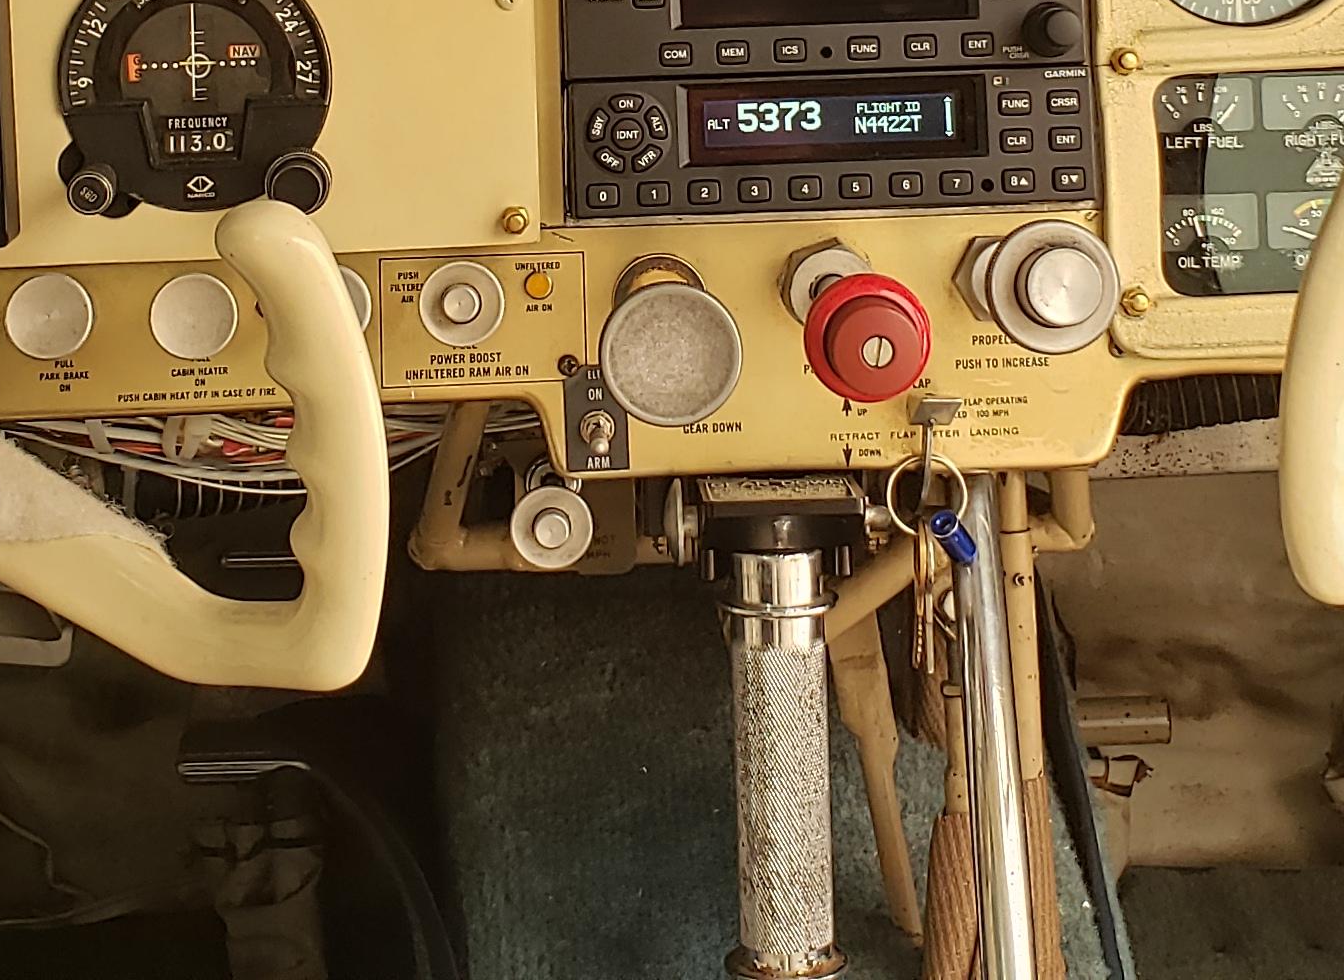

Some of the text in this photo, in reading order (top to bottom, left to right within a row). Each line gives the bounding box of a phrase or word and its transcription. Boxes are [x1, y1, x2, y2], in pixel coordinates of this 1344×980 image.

[782, 45, 799, 56] ICS
[851, 43, 877, 55] FUNC
[910, 41, 930, 52] CLR
[968, 39, 987, 51] ENT
[232, 46, 257, 57] NAV
[664, 49, 687, 60] COM
[721, 47, 745, 58] MEM
[1044, 69, 1086, 78] GARMIN
[618, 99, 634, 109] ON
[856, 102, 921, 114] FLIGHT ID
[1002, 98, 1029, 109] FUNC
[168, 117, 228, 129] FREQUENCY
[707, 101, 822, 133] ALT 5373
[854, 115, 922, 134] N4422T
[616, 130, 639, 141] IDNT
[168, 134, 226, 152] 113.0
[1165, 136, 1243, 149] LEFT FUEL
[1178, 256, 1239, 269] OIL TEMP
[429, 352, 501, 365] POWER BOOST
[955, 356, 1049, 370] PUSH TO INCREASE
[171, 366, 229, 378] CABIN HEATER
[405, 365, 529, 380] UNFILTERED RAM AIR ON
[118, 387, 276, 403] PUSH CABIN HEAT OFF IN CASE OF FIRE
[683, 421, 742, 435] GEAR DOWN
[587, 456, 611, 470] ARM
